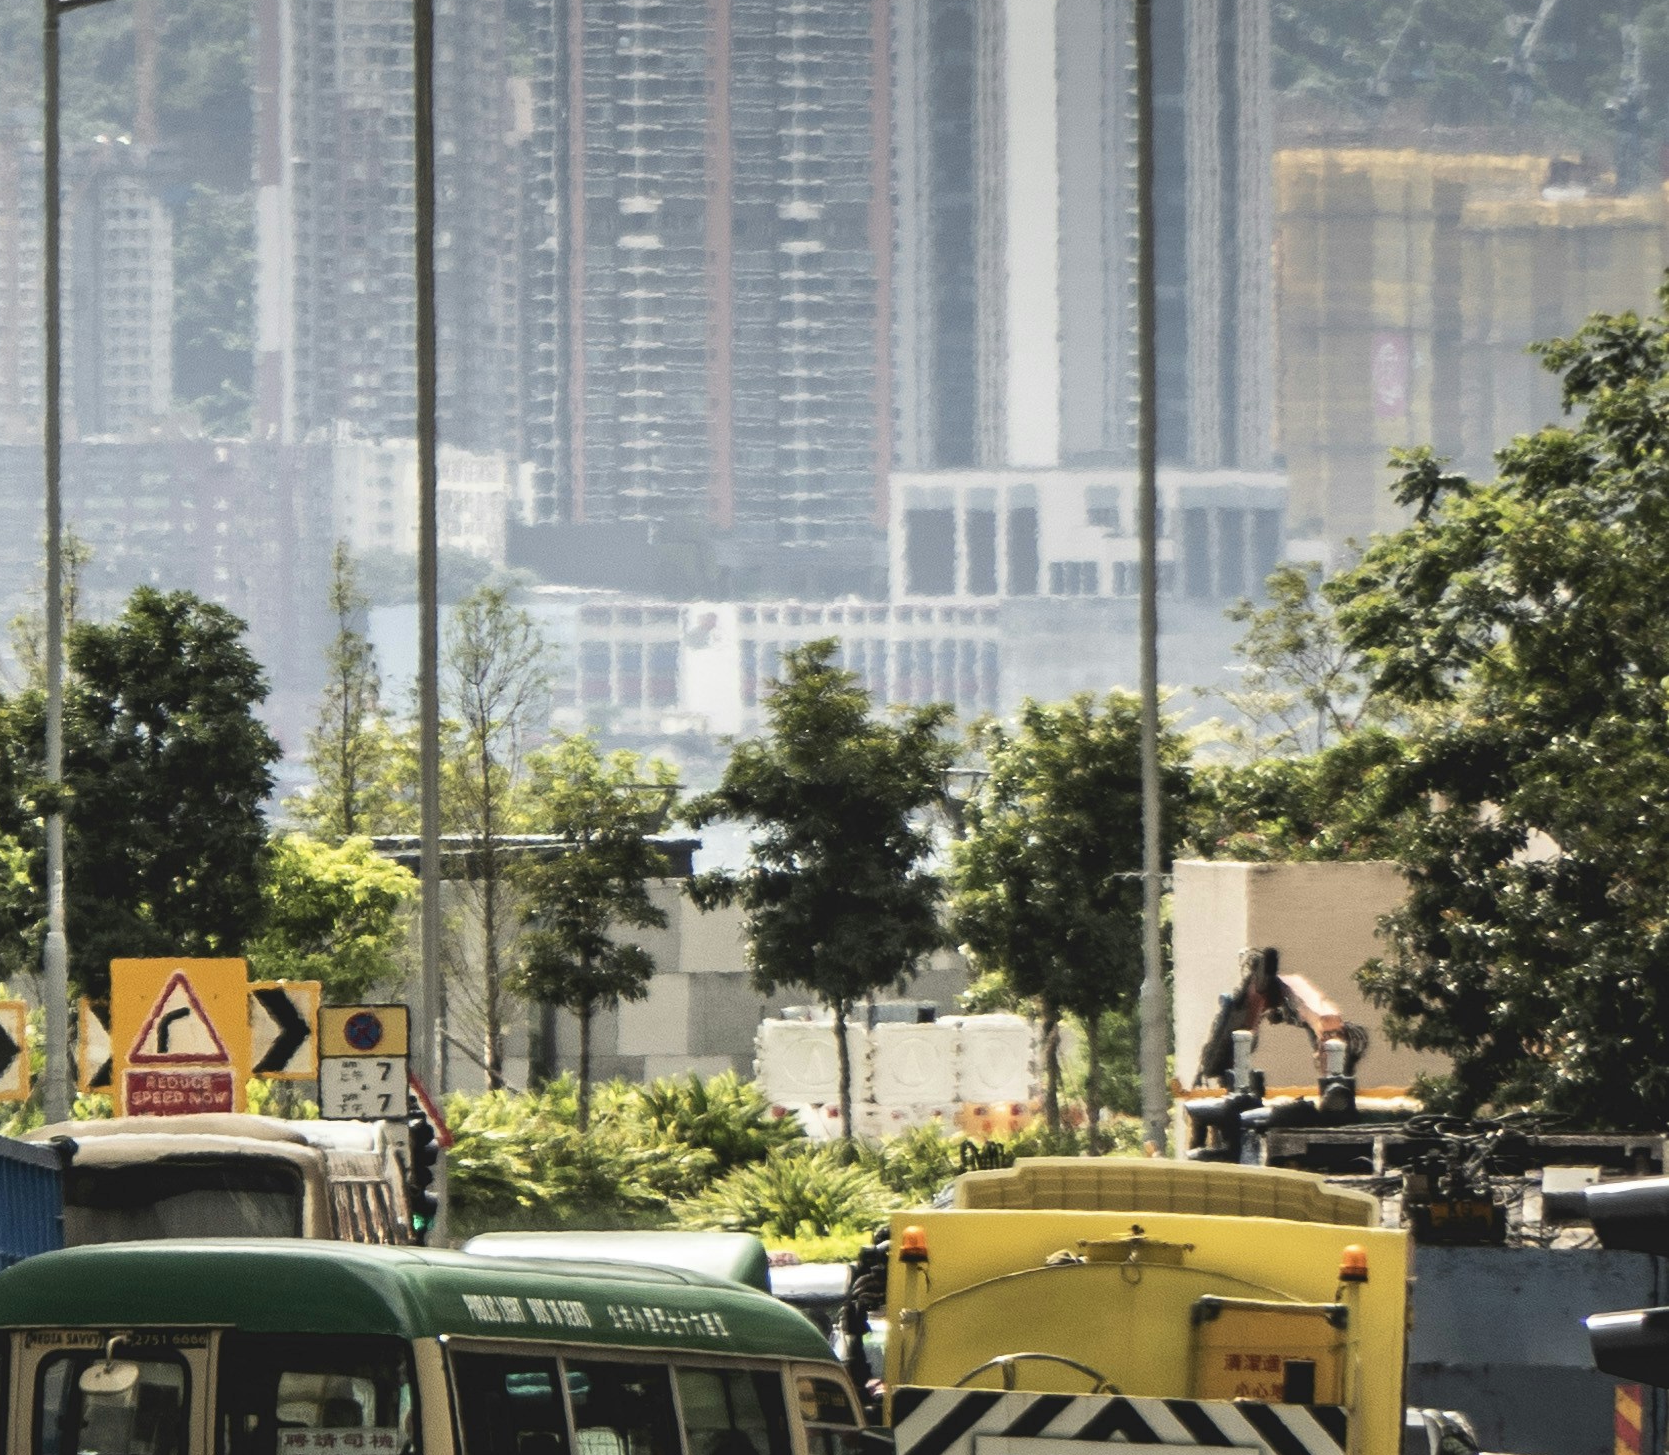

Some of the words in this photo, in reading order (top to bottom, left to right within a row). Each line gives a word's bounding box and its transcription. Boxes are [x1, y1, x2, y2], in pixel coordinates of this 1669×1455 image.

[376, 1061, 392, 1082] 7
[145, 1075, 212, 1090] REDUCE
[131, 1090, 185, 1106] SPEED
[188, 1091, 230, 1106] NOW
[377, 1093, 392, 1113] 7
